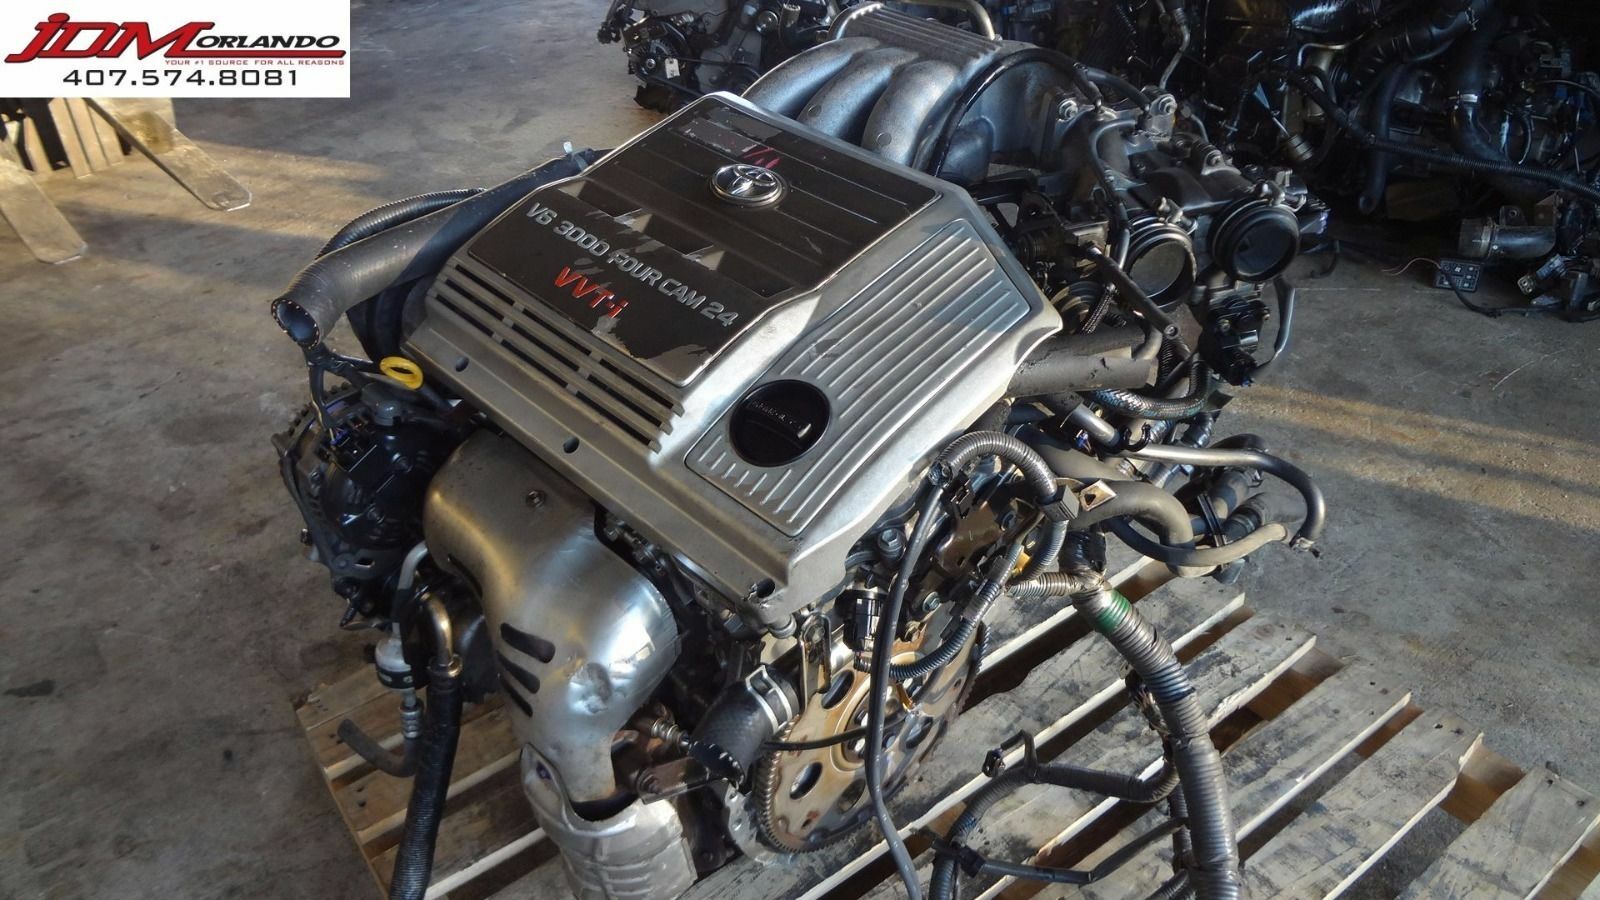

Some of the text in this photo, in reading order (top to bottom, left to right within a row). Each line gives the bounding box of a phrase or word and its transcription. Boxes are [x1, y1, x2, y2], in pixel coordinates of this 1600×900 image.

[526, 202, 739, 327] V6 3000 FOUR CAM 24
[553, 265, 630, 319] VVT-i
